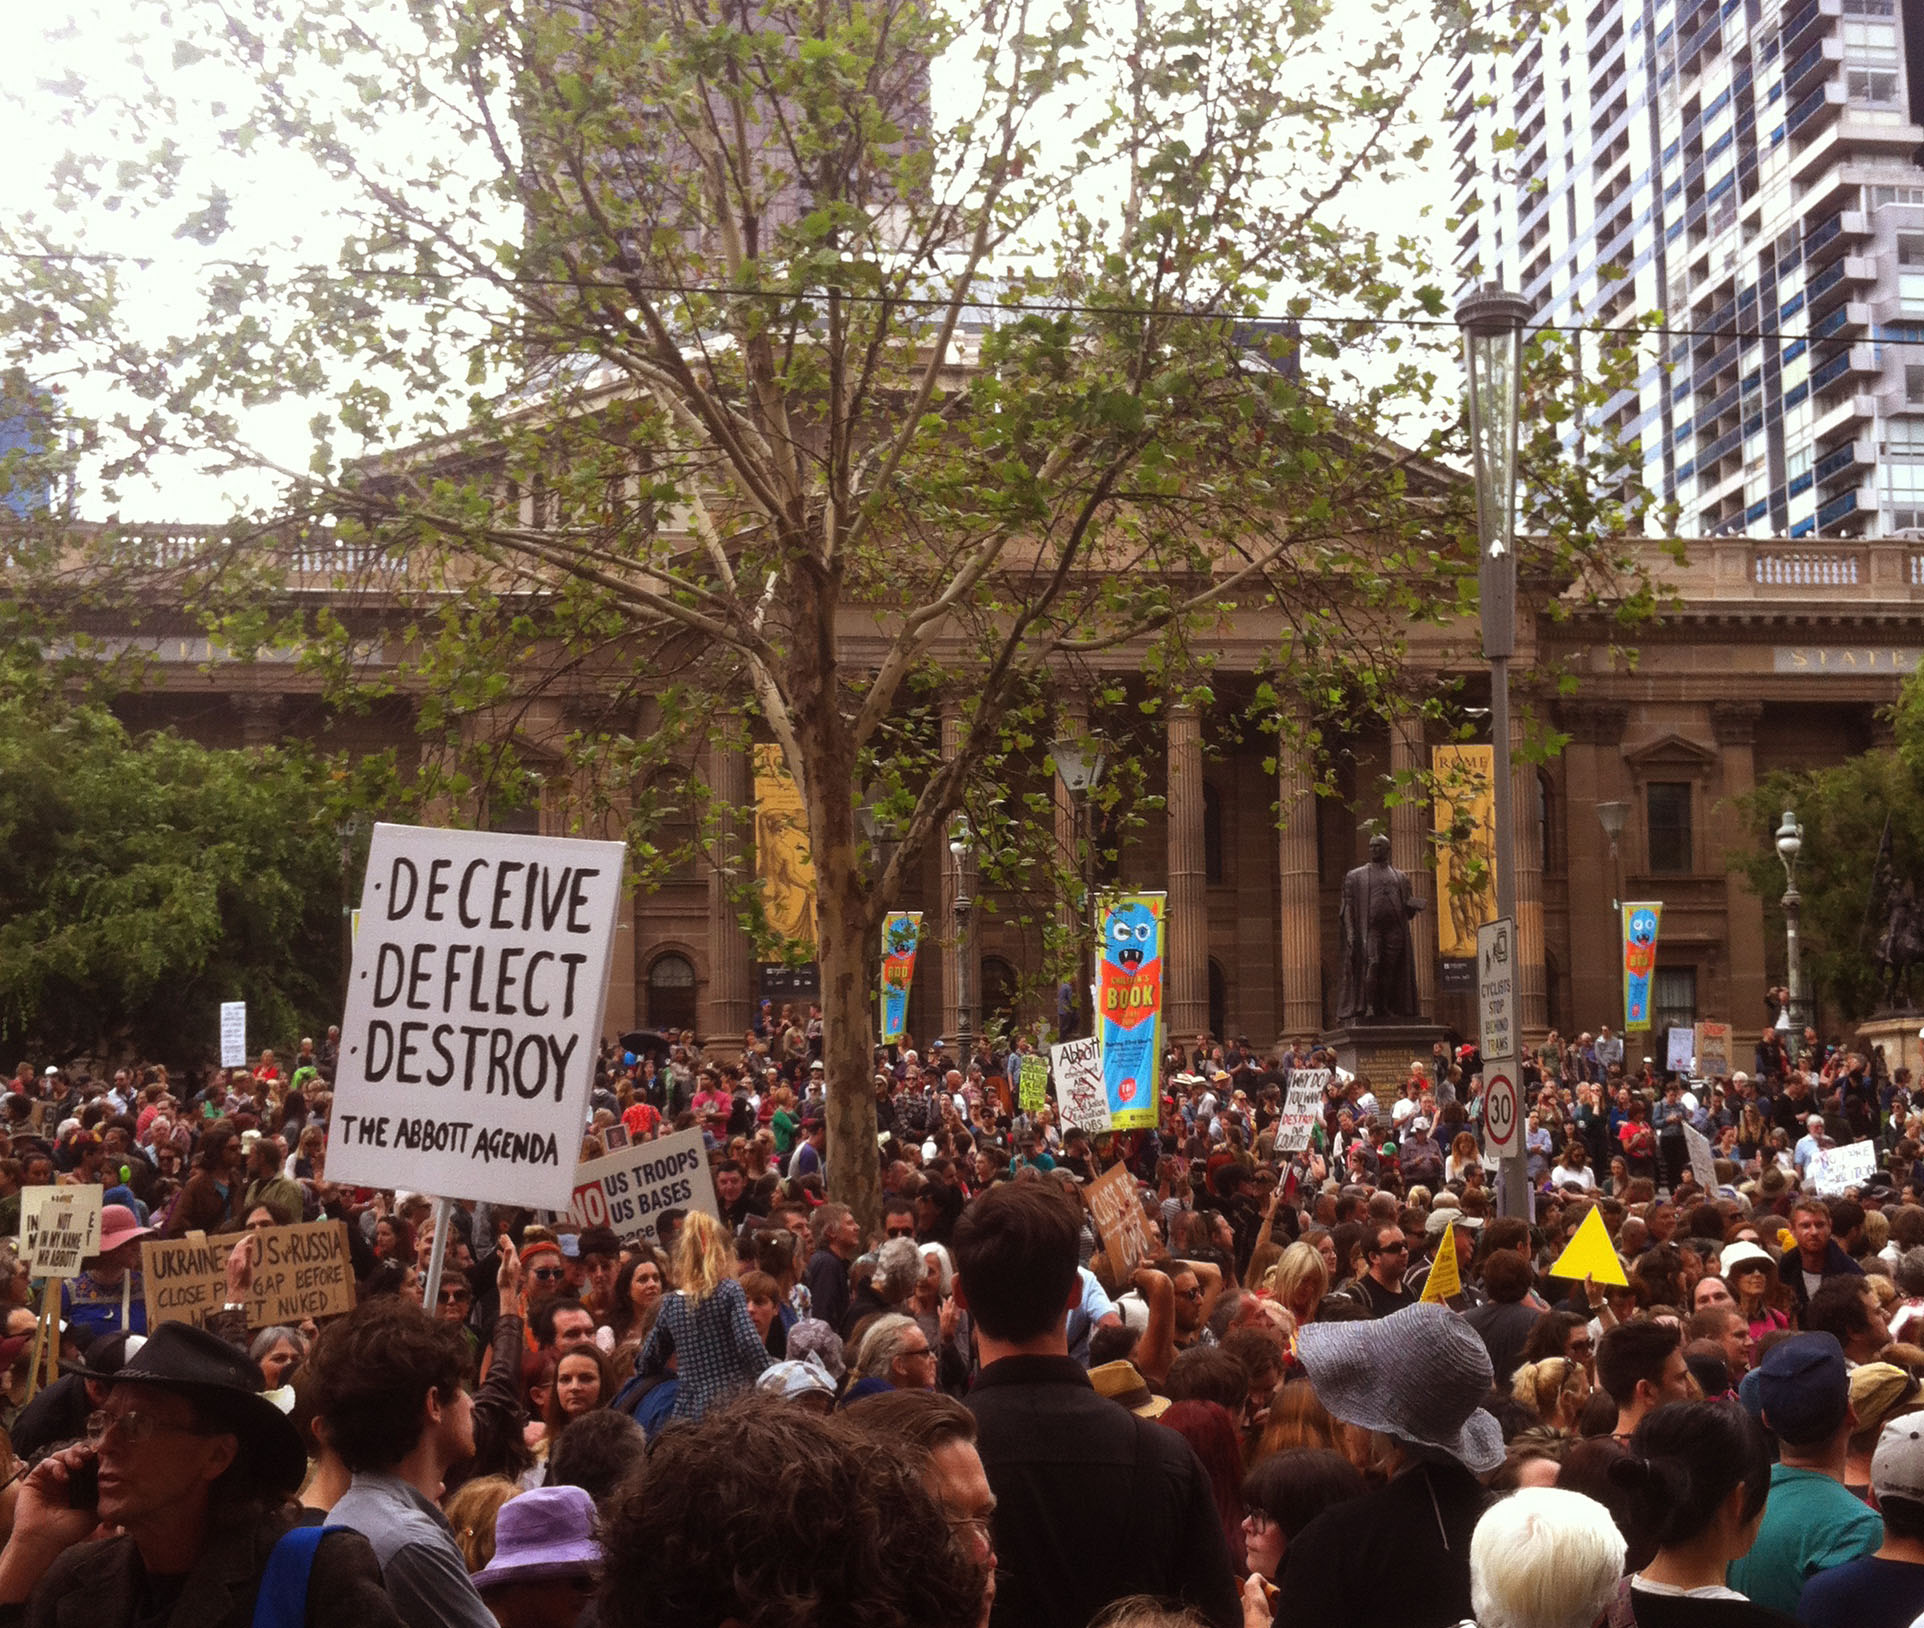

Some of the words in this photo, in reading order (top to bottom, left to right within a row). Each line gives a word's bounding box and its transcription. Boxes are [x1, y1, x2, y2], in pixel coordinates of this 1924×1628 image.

[1790, 650, 1905, 667] STATE
[387, 856, 600, 934] DECEIVE
[373, 942, 587, 1019] DEFLECT
[1481, 979, 1511, 998] CYCLISTS
[1107, 984, 1153, 1009] BOOK
[1489, 998, 1504, 1015] STOP
[1485, 1016, 1508, 1035] BEHIND
[1059, 1037, 1101, 1067] Abbott
[1487, 1034, 1508, 1053] TRAMS
[364, 1019, 579, 1103] DESTROY
[1292, 1071, 1311, 1088] WHY
[1310, 1072, 1325, 1087] DO
[1289, 1091, 1303, 1105] YOU
[1490, 1094, 1511, 1124] 30
[340, 1115, 390, 1149] THE
[393, 1118, 473, 1154] ABBOTT
[471, 1127, 559, 1167] AGENDA
[604, 1171, 629, 1197] US
[632, 1148, 699, 1188] TROOPS
[572, 1186, 606, 1228] NO
[610, 1199, 634, 1224] US
[638, 1179, 692, 1215] BASES
[57, 1212, 73, 1230] NOT
[49, 1231, 61, 1248] MY
[61, 1232, 82, 1249] NAME
[290, 1230, 343, 1266] RUSSIA
[37, 1250, 50, 1266] MR
[49, 1250, 78, 1267] ABBOTT
[158, 1283, 206, 1309] CLOSE
[252, 1273, 286, 1297] GAP
[295, 1264, 345, 1290] BEFORE
